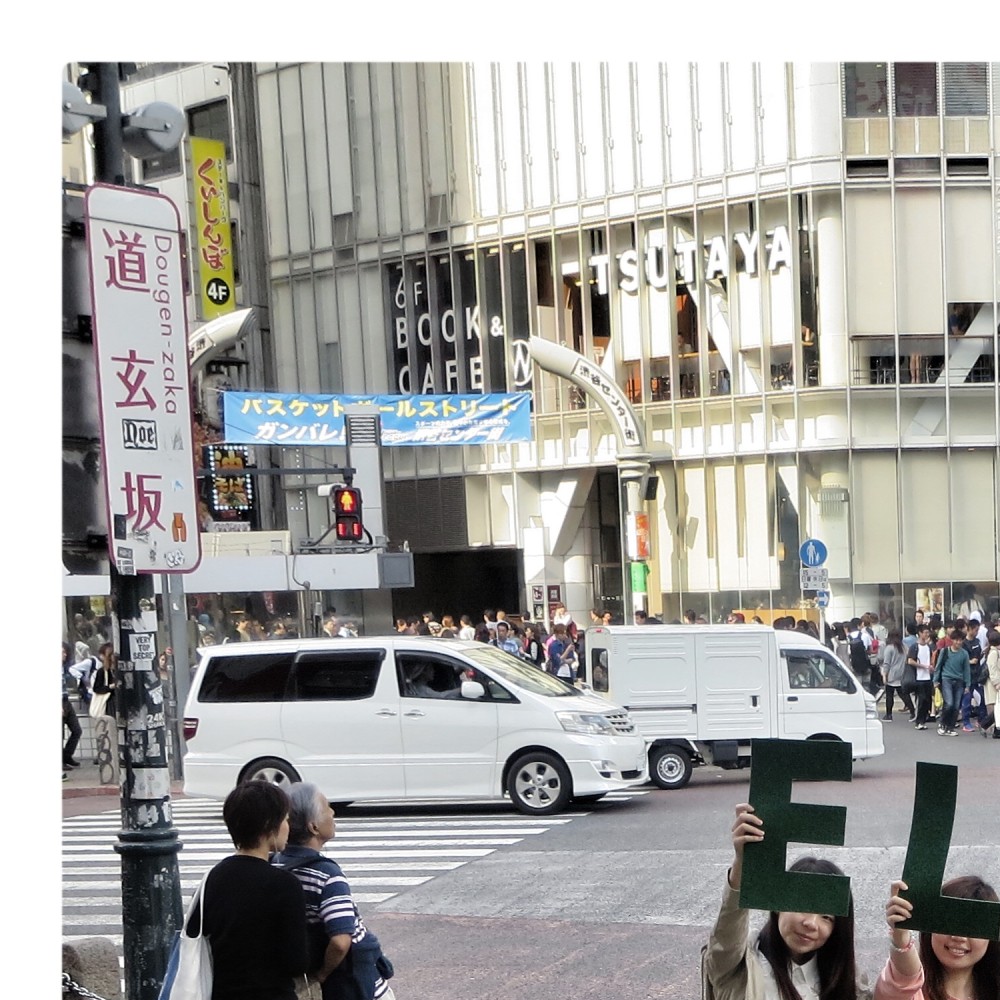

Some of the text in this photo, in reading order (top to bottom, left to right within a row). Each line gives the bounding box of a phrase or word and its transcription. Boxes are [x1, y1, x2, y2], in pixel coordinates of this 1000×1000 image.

[588, 225, 792, 295] TSUTAYA
[207, 282, 227, 300] 4F
[152, 235, 183, 414] Dougen-zaka
[395, 305, 480, 349] BOOK
[102, 228, 166, 532] 道玄坂
[240, 398, 518, 418] バスケットールストリート
[138, 644, 150, 652] TOP
